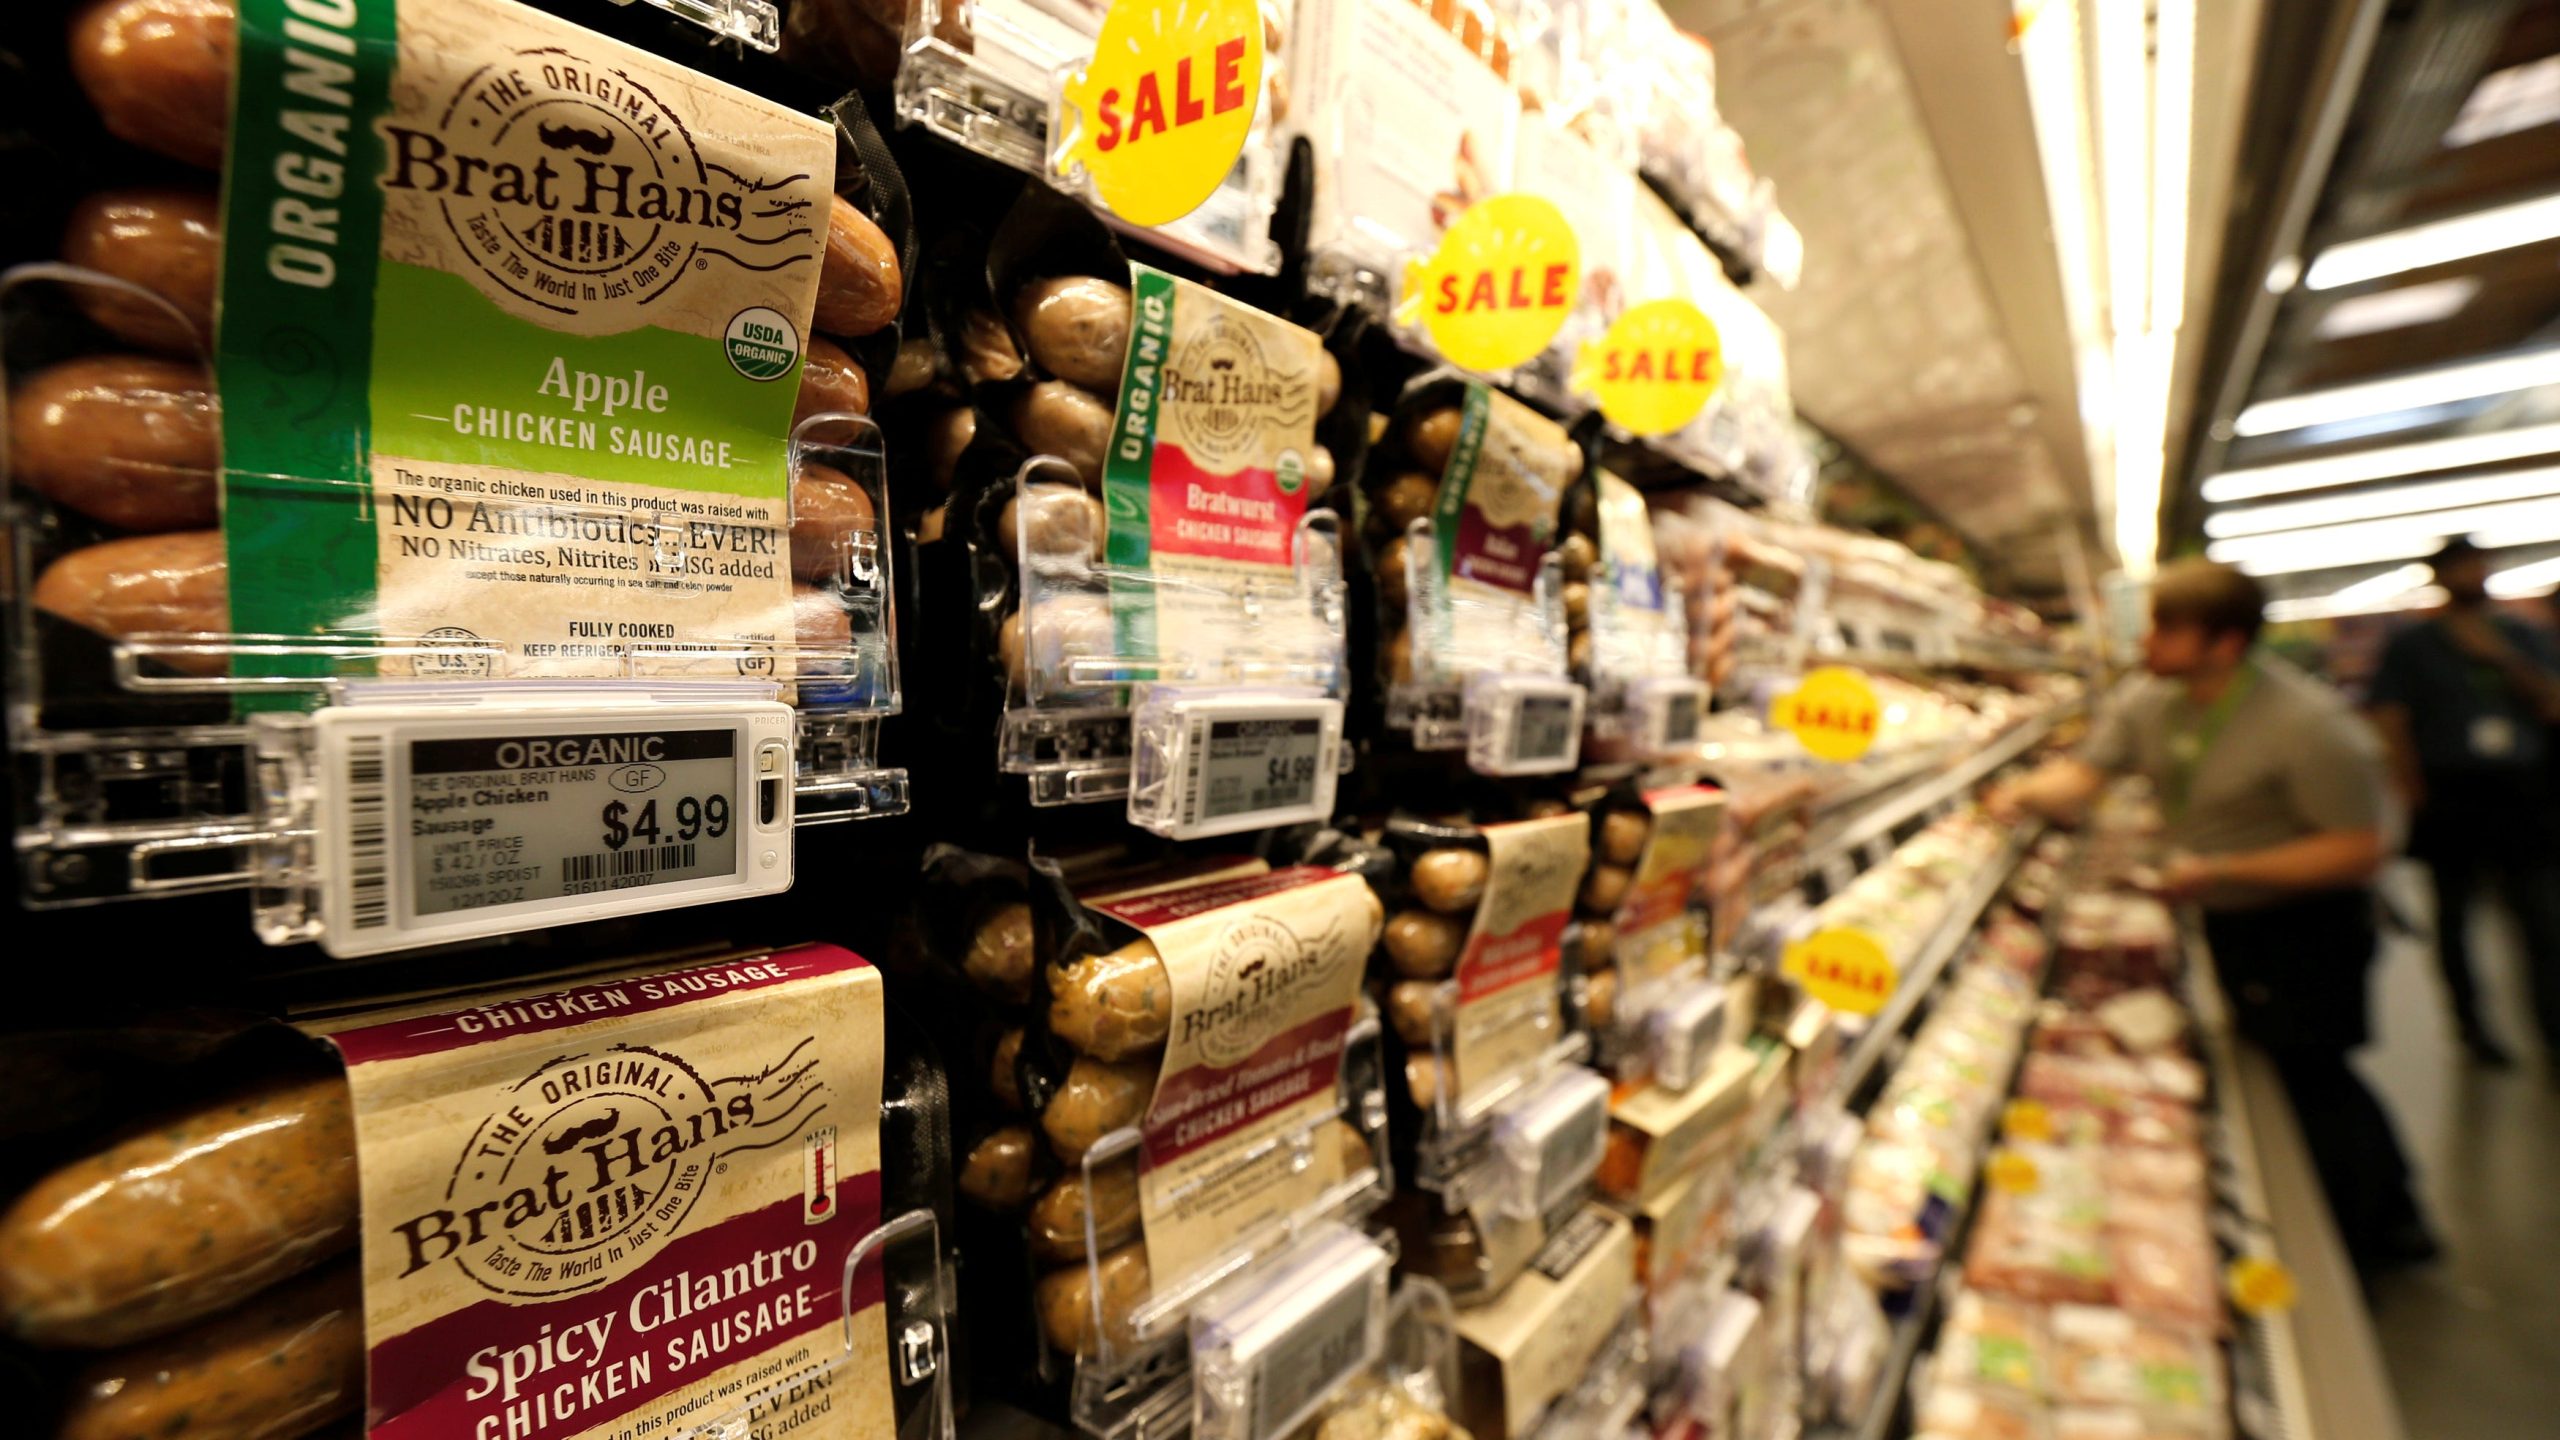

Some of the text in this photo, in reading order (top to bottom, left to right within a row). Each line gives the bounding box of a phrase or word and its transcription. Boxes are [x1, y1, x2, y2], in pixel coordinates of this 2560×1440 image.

[475, 70, 533, 115] THE
[543, 64, 672, 150] ORIGINAL
[1095, 36, 1246, 153] SALE
[269, 0, 359, 288] ORGANIC
[384, 125, 742, 231] Brat Hans
[466, 212, 681, 300] Taste The World In Just One Bite
[1436, 263, 1570, 314] SALE
[735, 343, 786, 365] ORGANIC
[743, 321, 784, 345] USDA
[537, 356, 669, 419] Apple
[1120, 294, 1165, 462] ORGANIC
[1162, 369, 1215, 404] Brat
[1603, 348, 1714, 384] SALE
[453, 403, 732, 470] CHICKEN SAUSAGE
[393, 494, 453, 530] NO
[394, 468, 769, 521] The organic chicken used in this product was raised with
[400, 536, 440, 558] NO
[449, 539, 551, 569] Nitrates,
[558, 546, 639, 571] Nitrites
[720, 559, 774, 579] added
[465, 570, 498, 582] except
[500, 571, 527, 582] those
[530, 573, 571, 586] naturally
[573, 577, 615, 589] occurring
[617, 578, 626, 587] in
[628, 580, 643, 588] sea
[705, 583, 733, 593] powder
[523, 643, 557, 657] KEEP
[569, 621, 675, 639] FULLY COOKED
[744, 657, 766, 670] GF
[754, 716, 786, 725] PRICER
[496, 736, 665, 769] ORGANIC
[412, 769, 596, 791] THE ORIGINAL BRAT HANS
[412, 790, 549, 814] Apple Chicken
[626, 771, 650, 786] GF
[412, 818, 495, 836] Sausage
[477, 836, 524, 850] PRICE
[602, 794, 729, 851] $4.99
[455, 989, 631, 1035] CHICKEN
[645, 961, 789, 1000] SAUSAGE
[478, 1105, 533, 1159] THE
[541, 1061, 675, 1104] ORIGINAL
[391, 1092, 754, 1280] Brat Hans
[484, 1163, 699, 1282] Taste The World In Just One Bite
[465, 1310, 618, 1404] Spicy
[628, 1239, 818, 1333] Cilantro
[476, 1351, 652, 1440] CHICKEN
[668, 1284, 813, 1372] SAUSAGE
[636, 1416, 662, 1436] this
[666, 1391, 715, 1428] product
[718, 1378, 742, 1398] was
[746, 1363, 783, 1386] raised
[786, 1348, 810, 1368] with
[778, 1393, 831, 1435] added
